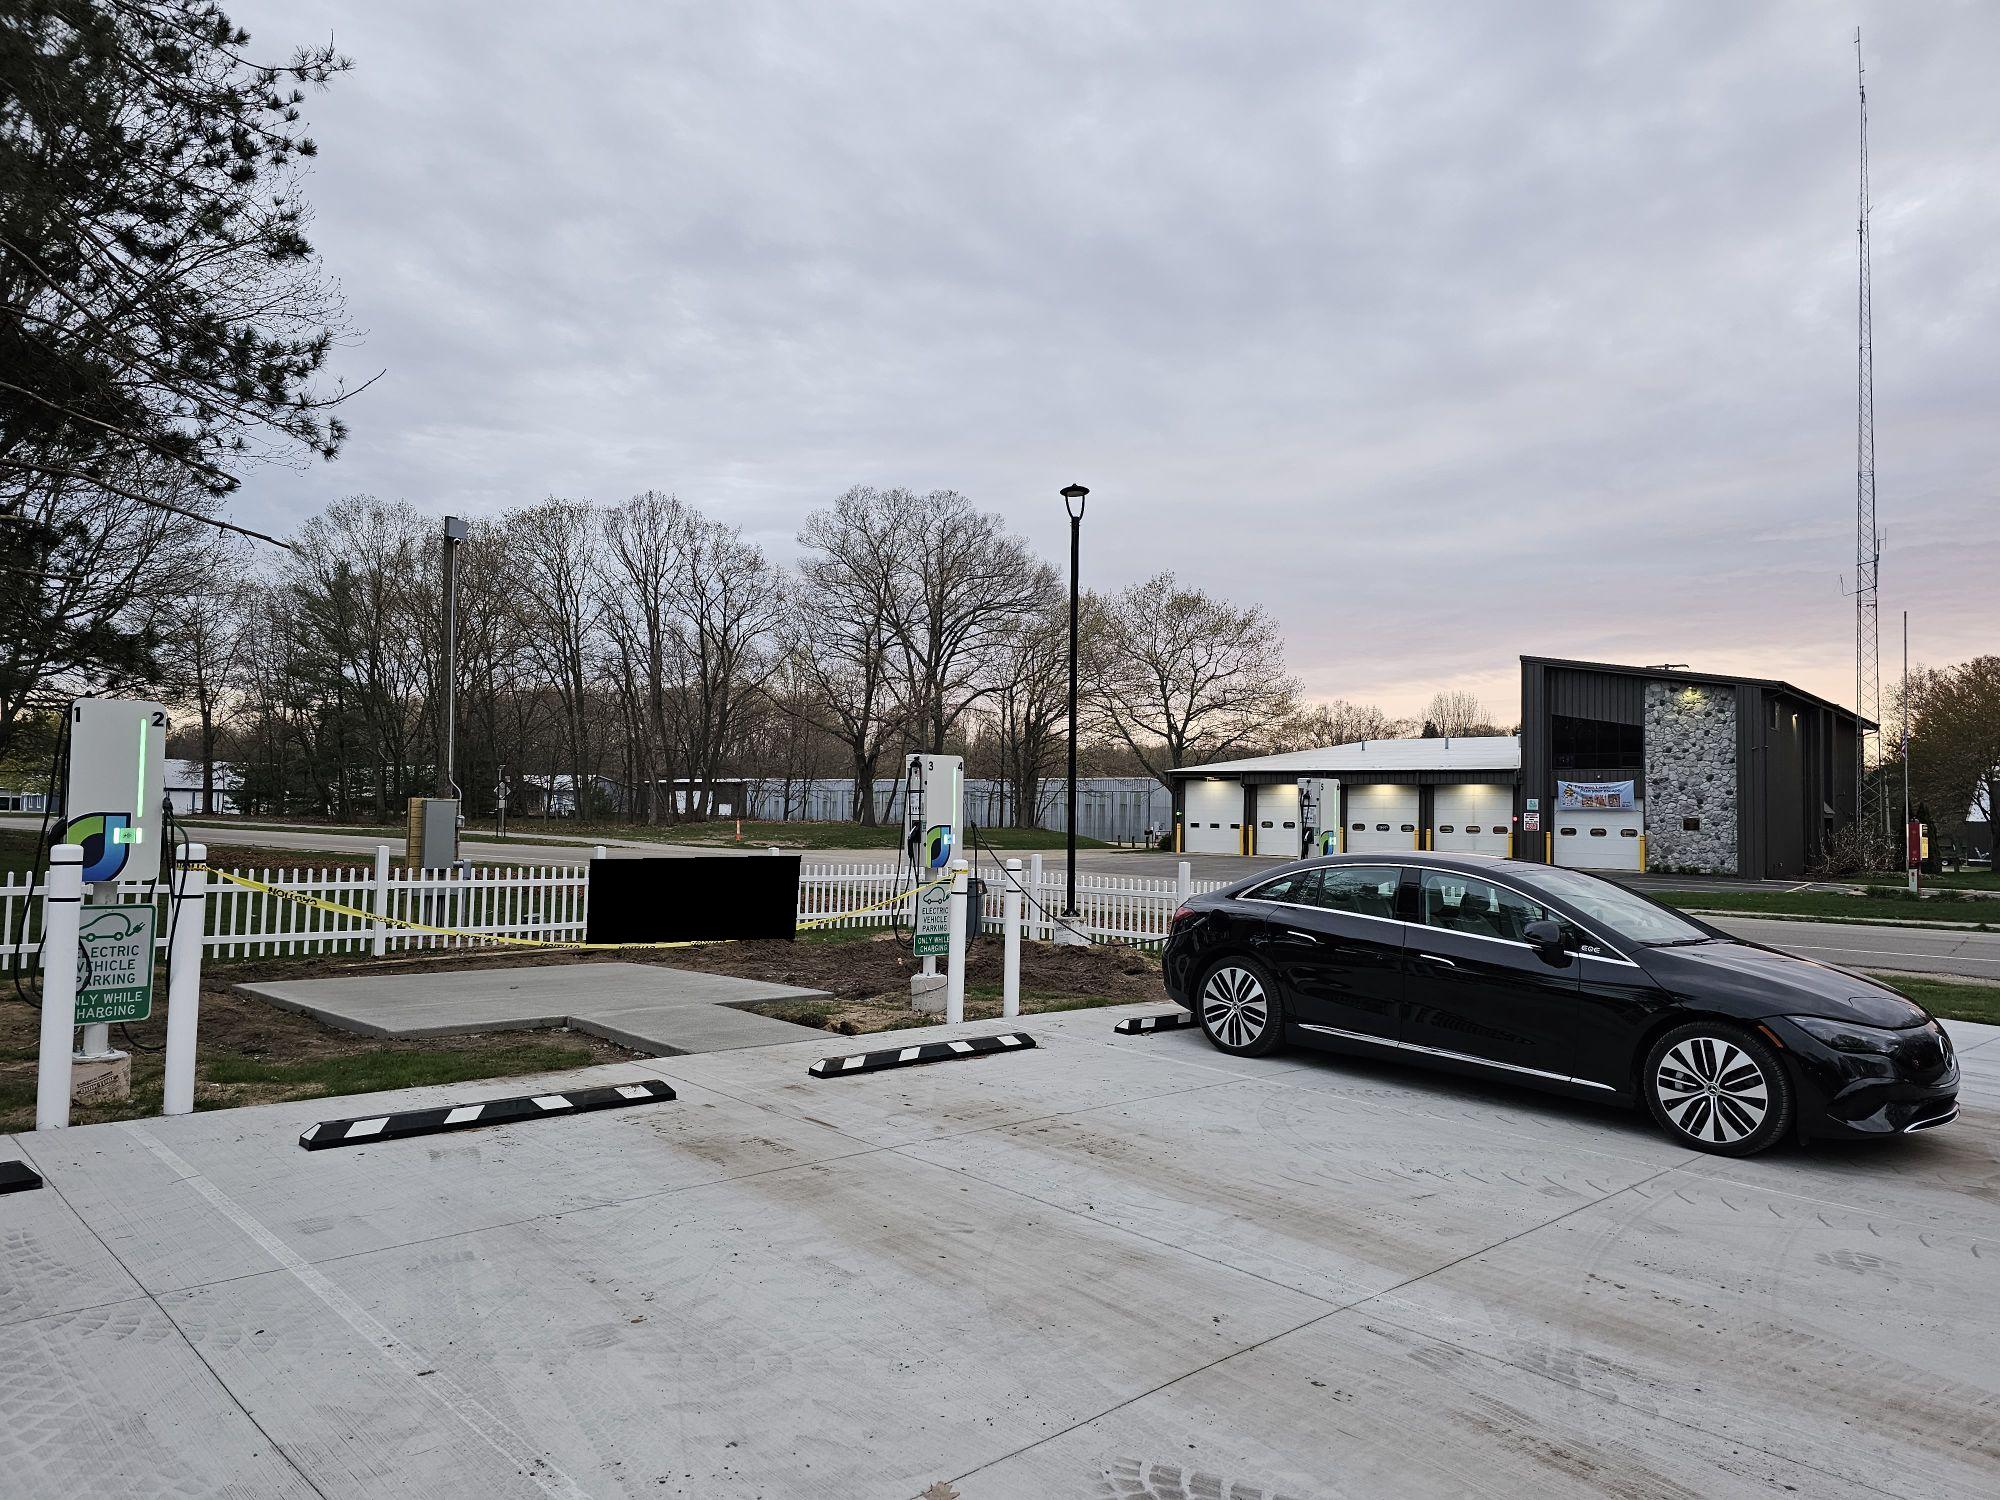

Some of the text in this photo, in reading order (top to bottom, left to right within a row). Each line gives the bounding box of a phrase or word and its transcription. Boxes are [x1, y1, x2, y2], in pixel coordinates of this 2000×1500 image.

[73, 706, 81, 723] 1
[151, 711, 165, 727] 2
[928, 761, 934, 771] 3
[957, 761, 963, 772] 4
[922, 906, 949, 915] ELECTRIC
[923, 915, 948, 924] VEHICLE
[922, 924, 948, 932] PARKING
[917, 937, 933, 945] ONLY
[77, 944, 140, 959] ECTRIC
[920, 944, 948, 953] CHARGING
[1581, 944, 1601, 954] EQE
[76, 972, 136, 987] PRKING
[75, 991, 143, 1007] NLY WHILE
[76, 1004, 136, 1020] HARGING
